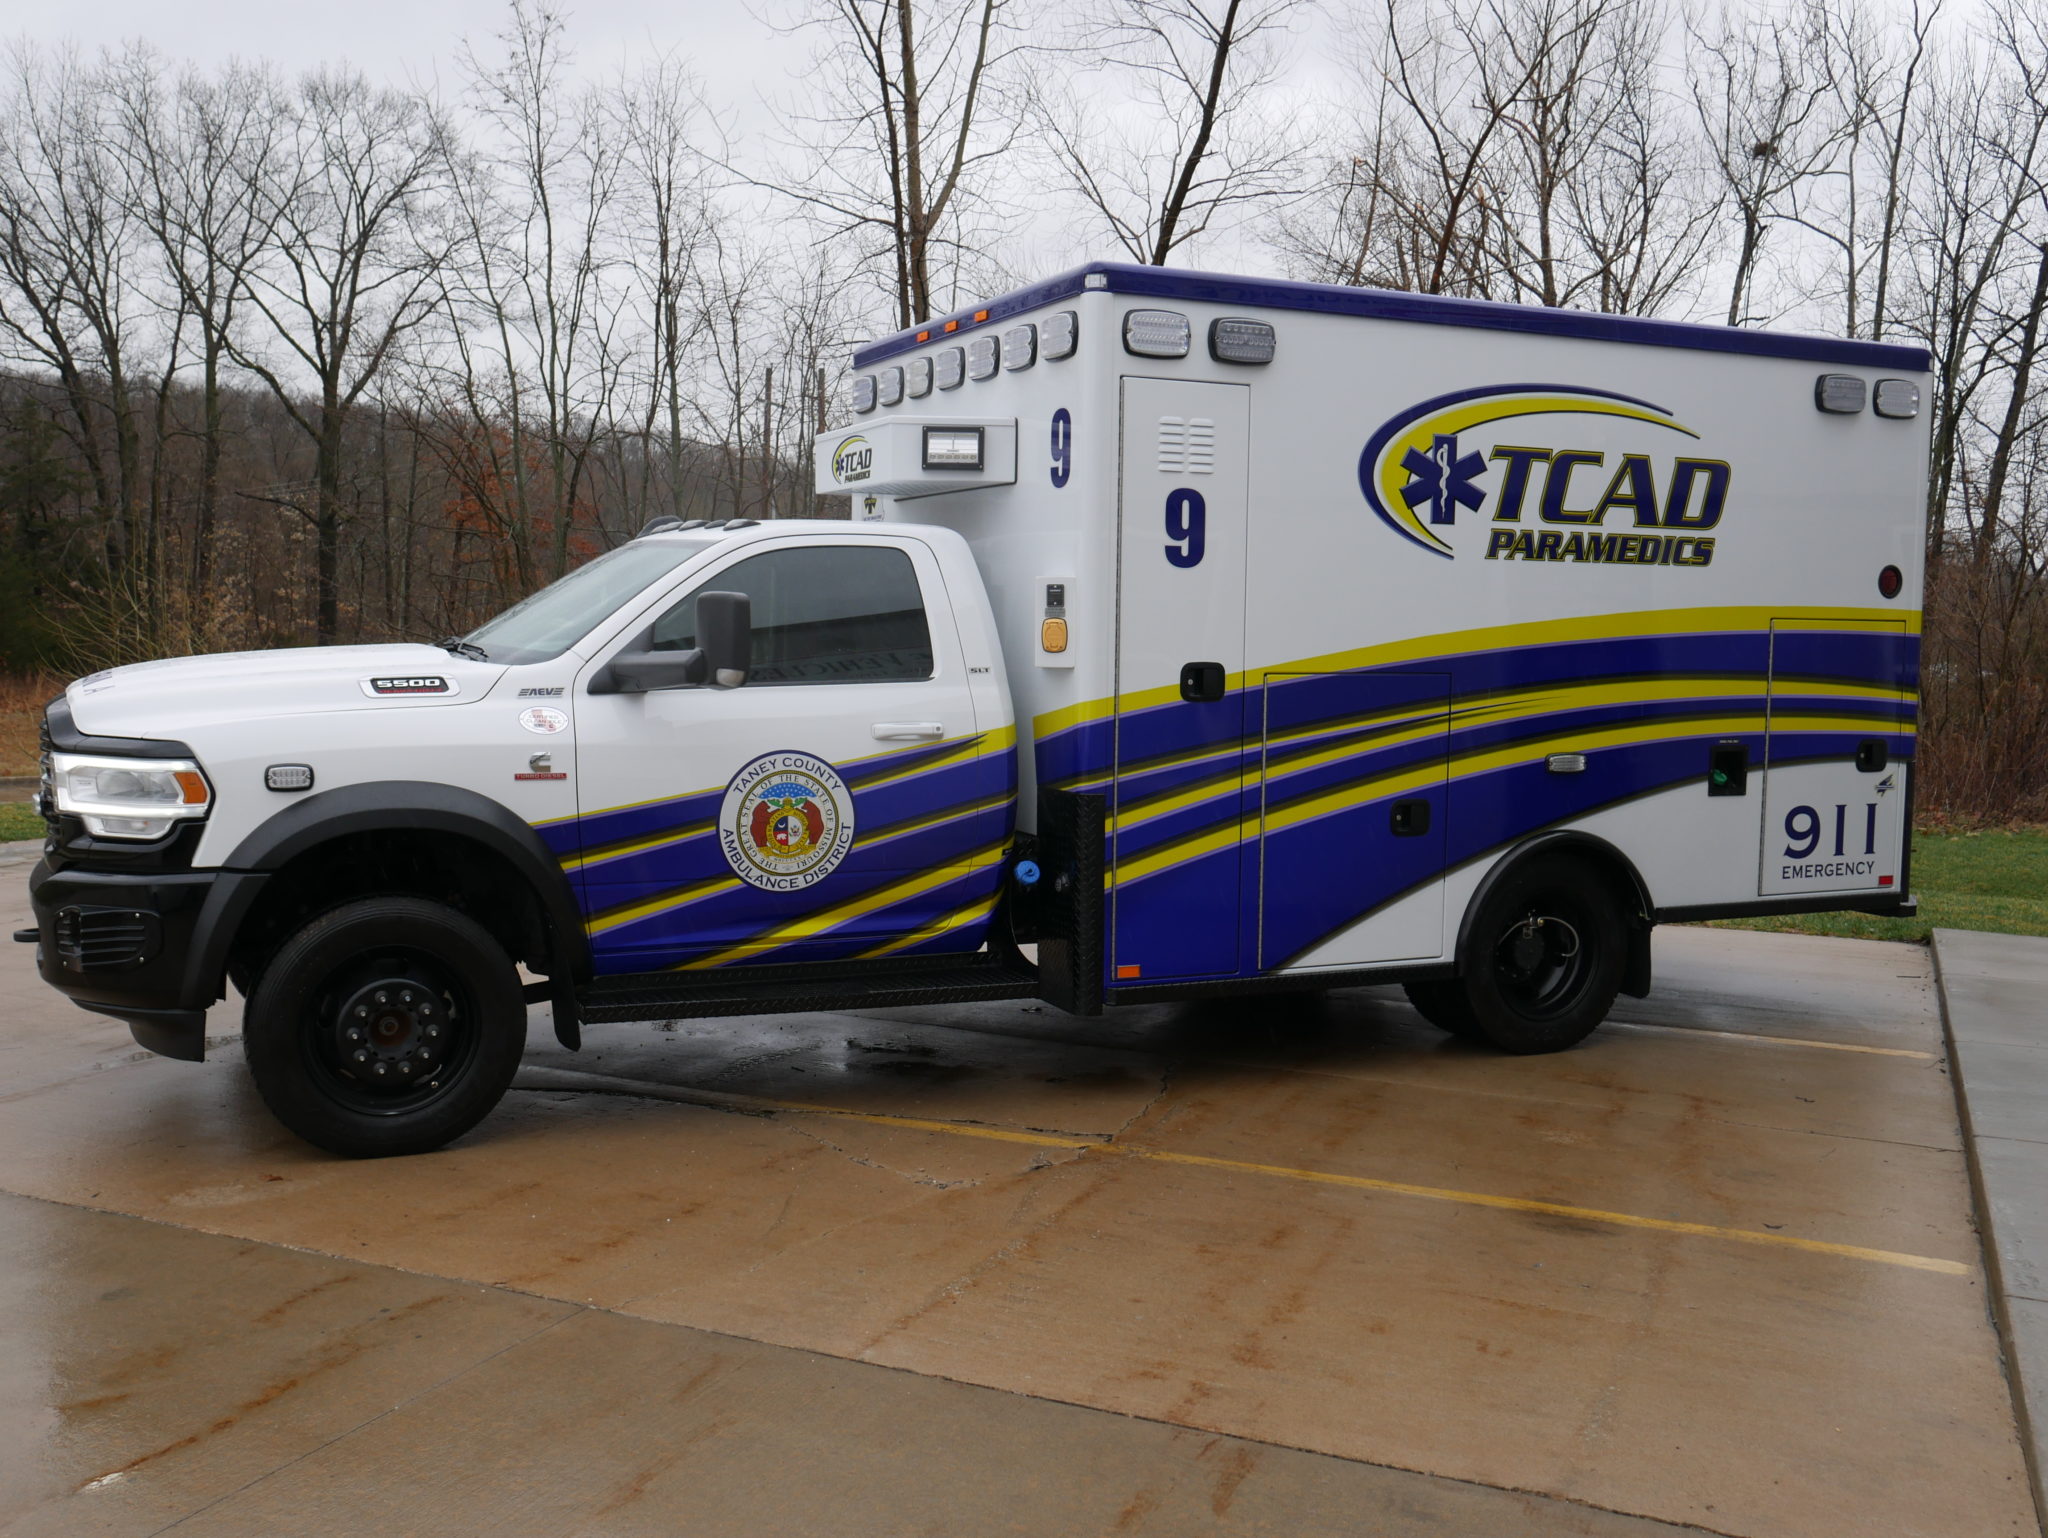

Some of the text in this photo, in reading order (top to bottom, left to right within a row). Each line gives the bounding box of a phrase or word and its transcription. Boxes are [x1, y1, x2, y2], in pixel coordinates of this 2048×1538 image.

[844, 448, 872, 473] TCAD
[1050, 407, 1071, 489] 9
[844, 469, 871, 484] PARAMEDICS
[1488, 444, 1732, 531] TCAD
[1165, 487, 1206, 569] 9
[1484, 527, 1716, 567] PARAMEDICS
[376, 679, 440, 688] 5500
[733, 757, 841, 794] TANEY COUNTY
[740, 774, 834, 871] THE GREAT SEAL OF THE STATE OF MISSOURI
[1783, 803, 1878, 860] 911
[723, 828, 800, 890] AMBULANCE
[802, 821, 852, 885] DISTRICT
[1781, 860, 1875, 880] EMERGENCY
